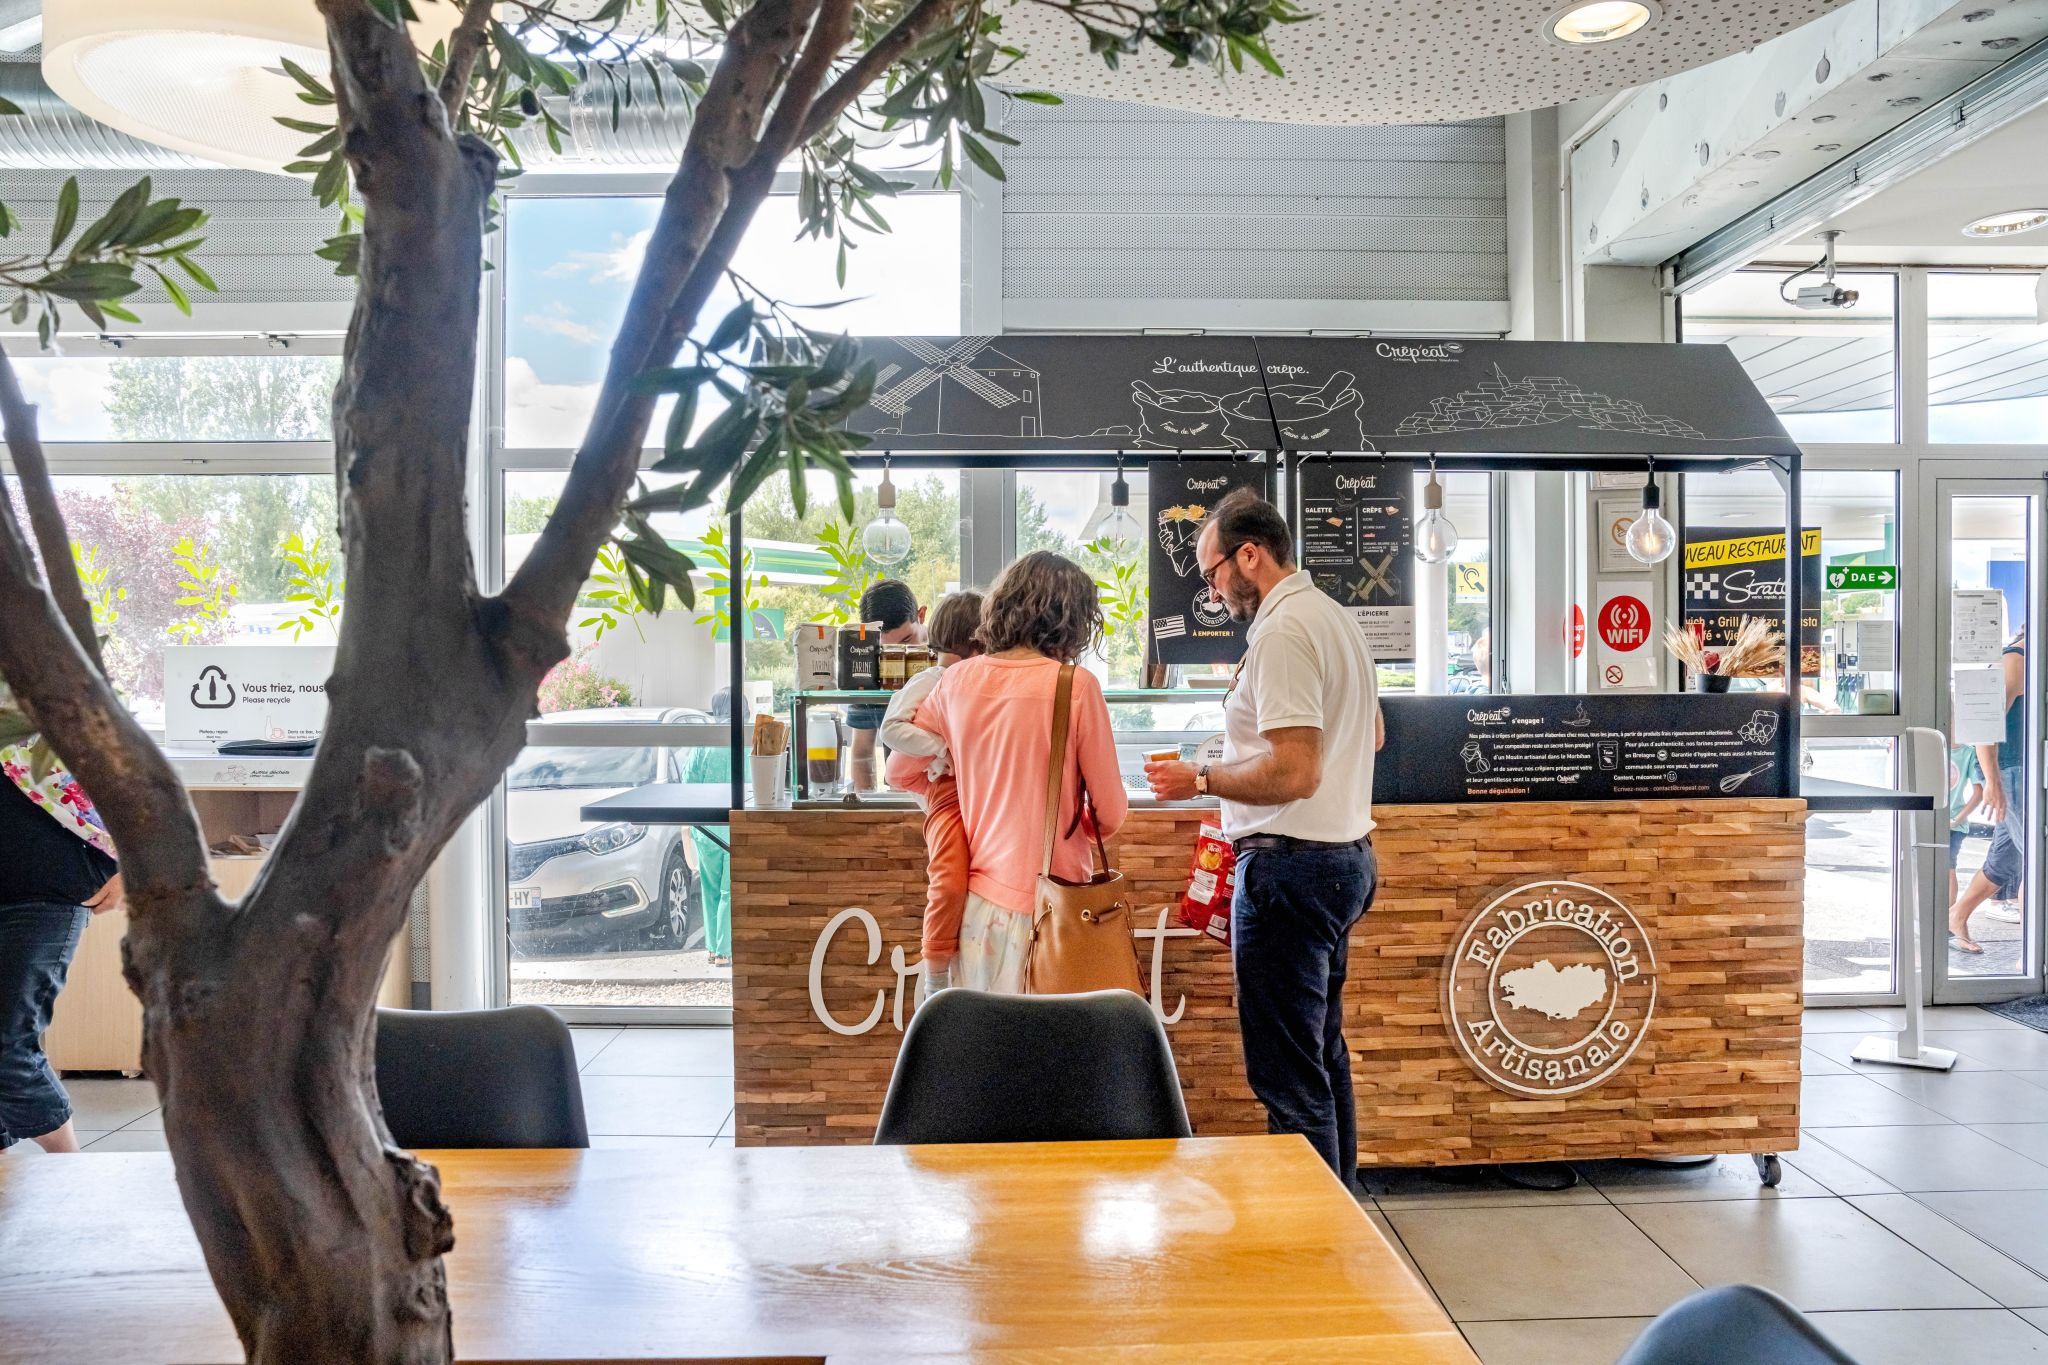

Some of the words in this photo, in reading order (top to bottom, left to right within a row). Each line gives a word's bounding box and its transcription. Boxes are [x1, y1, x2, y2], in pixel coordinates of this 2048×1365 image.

[1376, 342, 1449, 363] Crêp'eat
[1152, 356, 1258, 378] L'authentique
[1266, 365, 1310, 379] crêpe.
[1187, 478, 1220, 494] Crêp'eat
[1336, 475, 1377, 495] Crêp'eat
[1362, 506, 1382, 514] CRÊPE
[1728, 534, 1817, 560] RESTAURNT
[1851, 573, 1875, 582] DAE
[1717, 616, 1739, 628] Grill
[1606, 629, 1644, 644] WIFI
[852, 661, 873, 673] FARINE
[242, 683, 267, 693] Vous
[269, 683, 296, 695] triez,
[299, 684, 325, 693] nous
[242, 696, 266, 704] Please
[266, 696, 291, 705] recycle
[1467, 709, 1503, 727] Crêp'eat
[1511, 717, 1540, 725] s'engage
[1467, 787, 1488, 795] Bonne
[1488, 787, 1526, 796] dégustation
[1465, 894, 1640, 984] Fabrication
[1467, 1019, 1630, 1080] Artisanale
